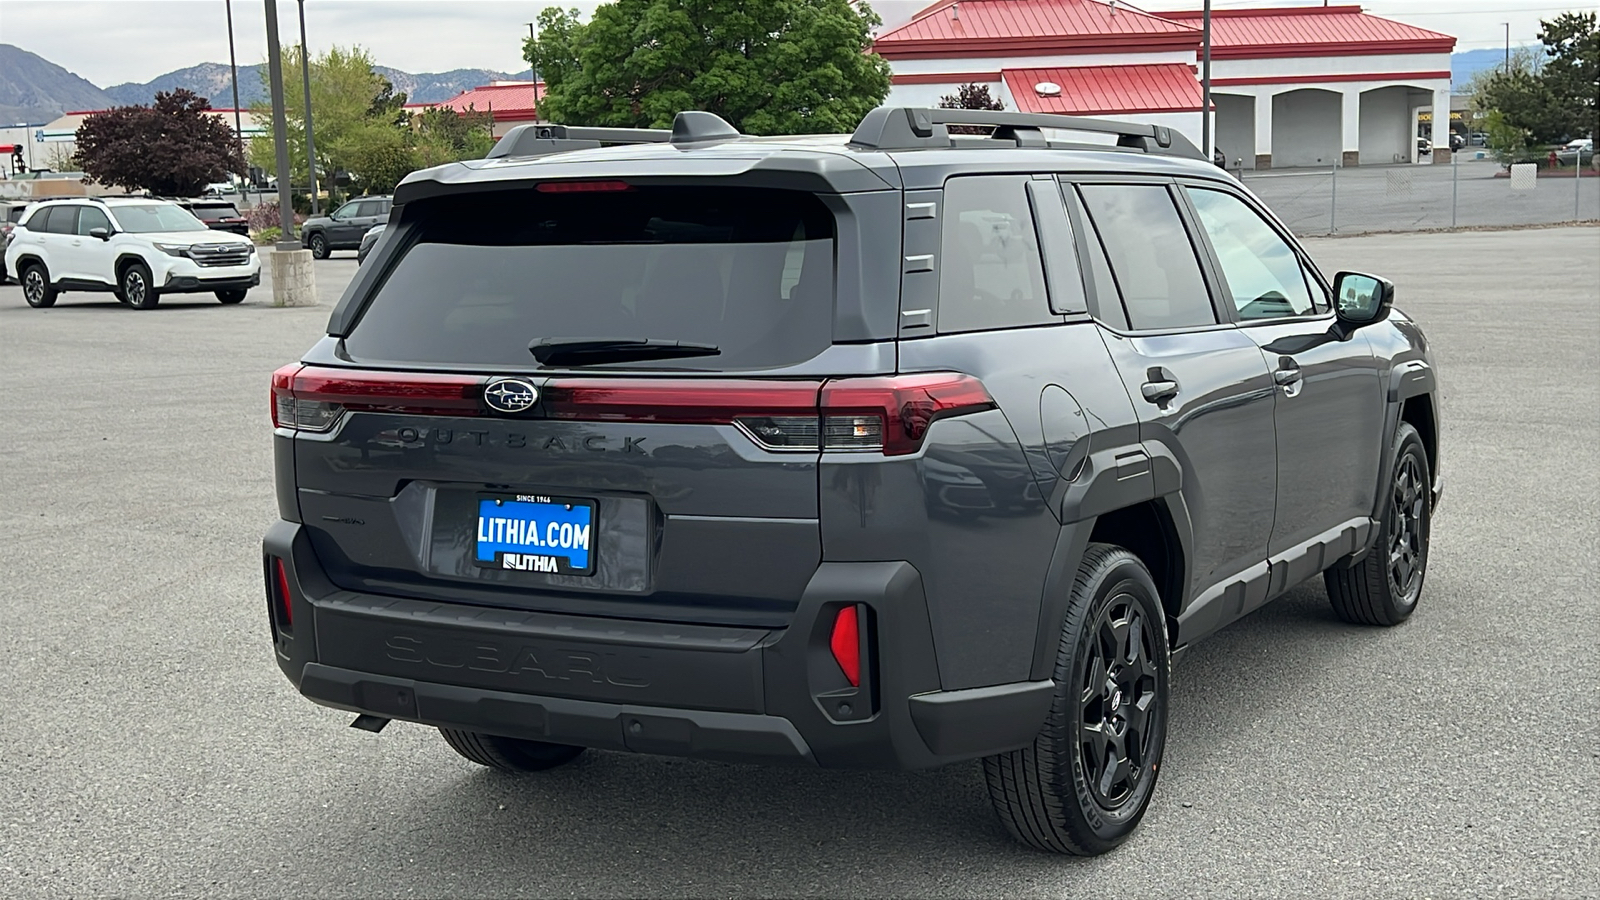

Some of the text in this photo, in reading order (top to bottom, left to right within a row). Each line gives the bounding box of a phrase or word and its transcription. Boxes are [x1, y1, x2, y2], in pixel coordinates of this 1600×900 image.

[398, 427, 647, 455] OUTBACK
[516, 494, 551, 504] SINCE 1946
[478, 516, 590, 551] LITHIA.COM
[515, 554, 558, 572] LITHIA
[385, 631, 651, 689] SUBARU
